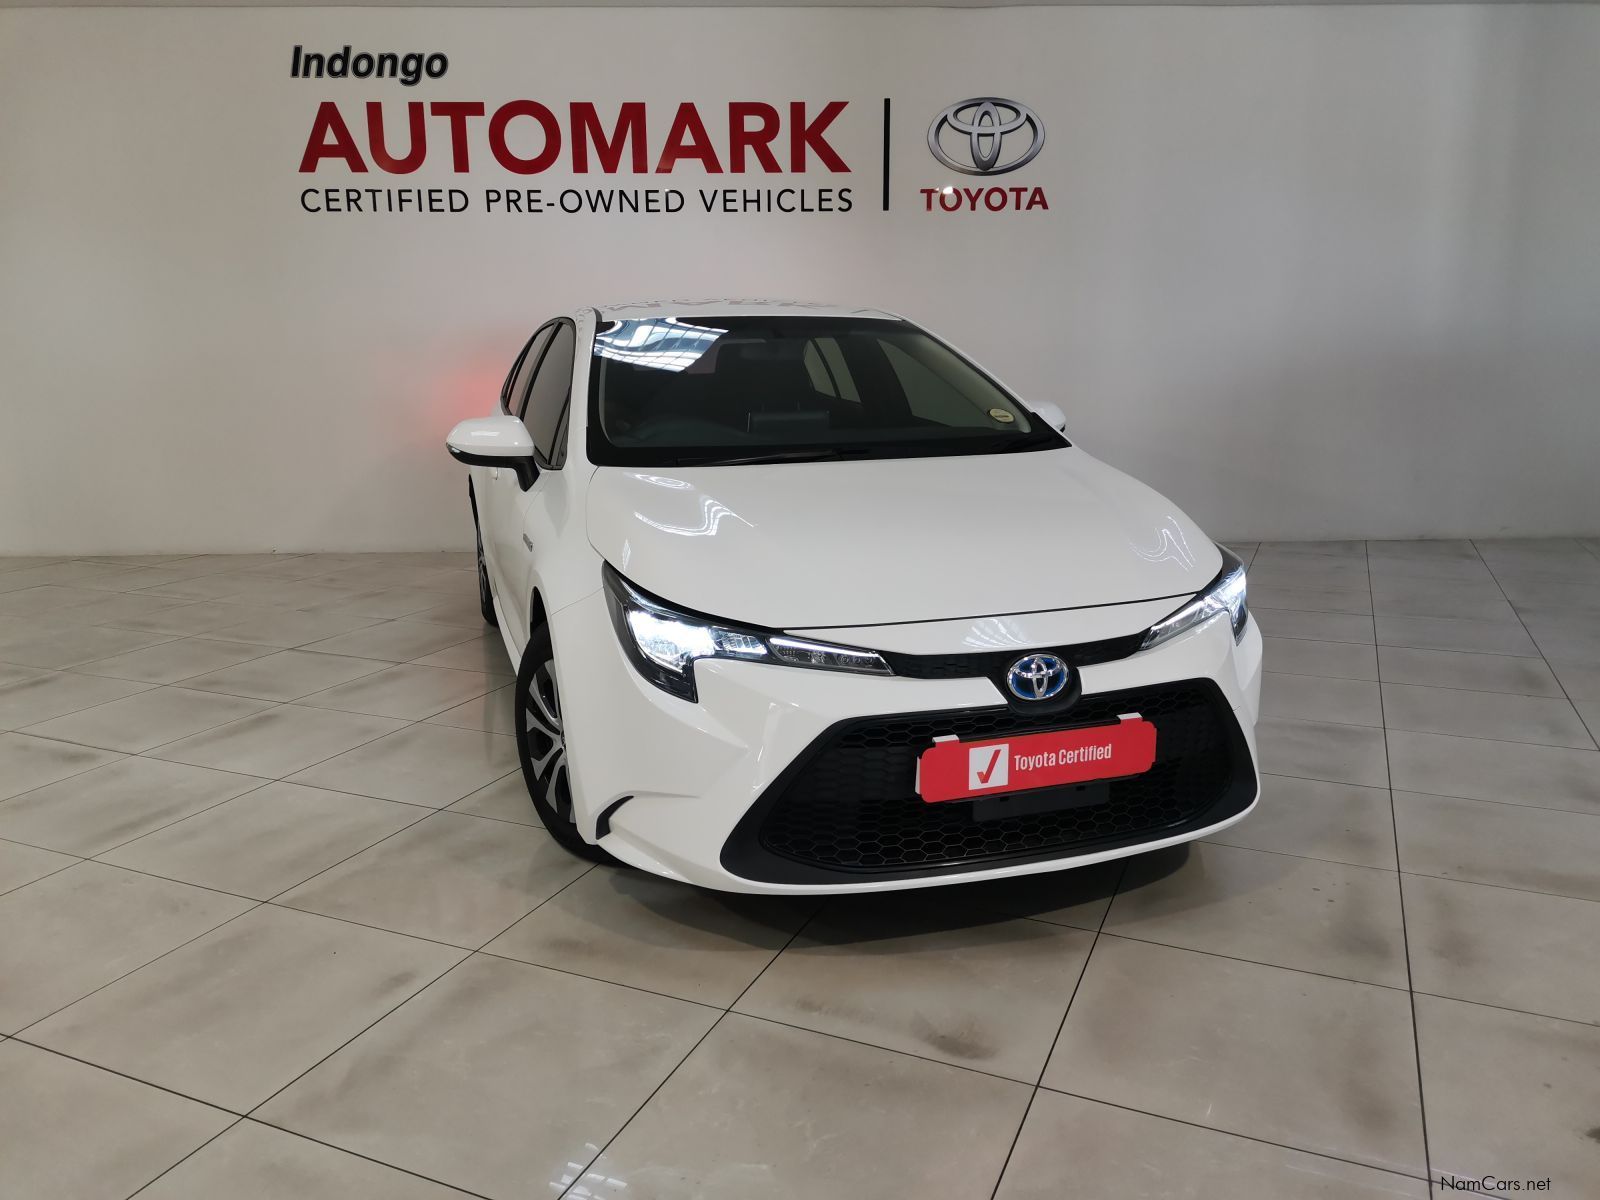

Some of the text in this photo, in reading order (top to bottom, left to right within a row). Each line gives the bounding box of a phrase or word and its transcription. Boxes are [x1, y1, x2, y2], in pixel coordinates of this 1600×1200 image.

[290, 44, 449, 87] Indongo
[298, 99, 852, 175] AUTOMARK
[300, 188, 853, 213] CERTIFIED PRE-OWNED VEHICLES
[919, 186, 1049, 213] TOYOTA
[1014, 743, 1112, 771] Toyota Certified
